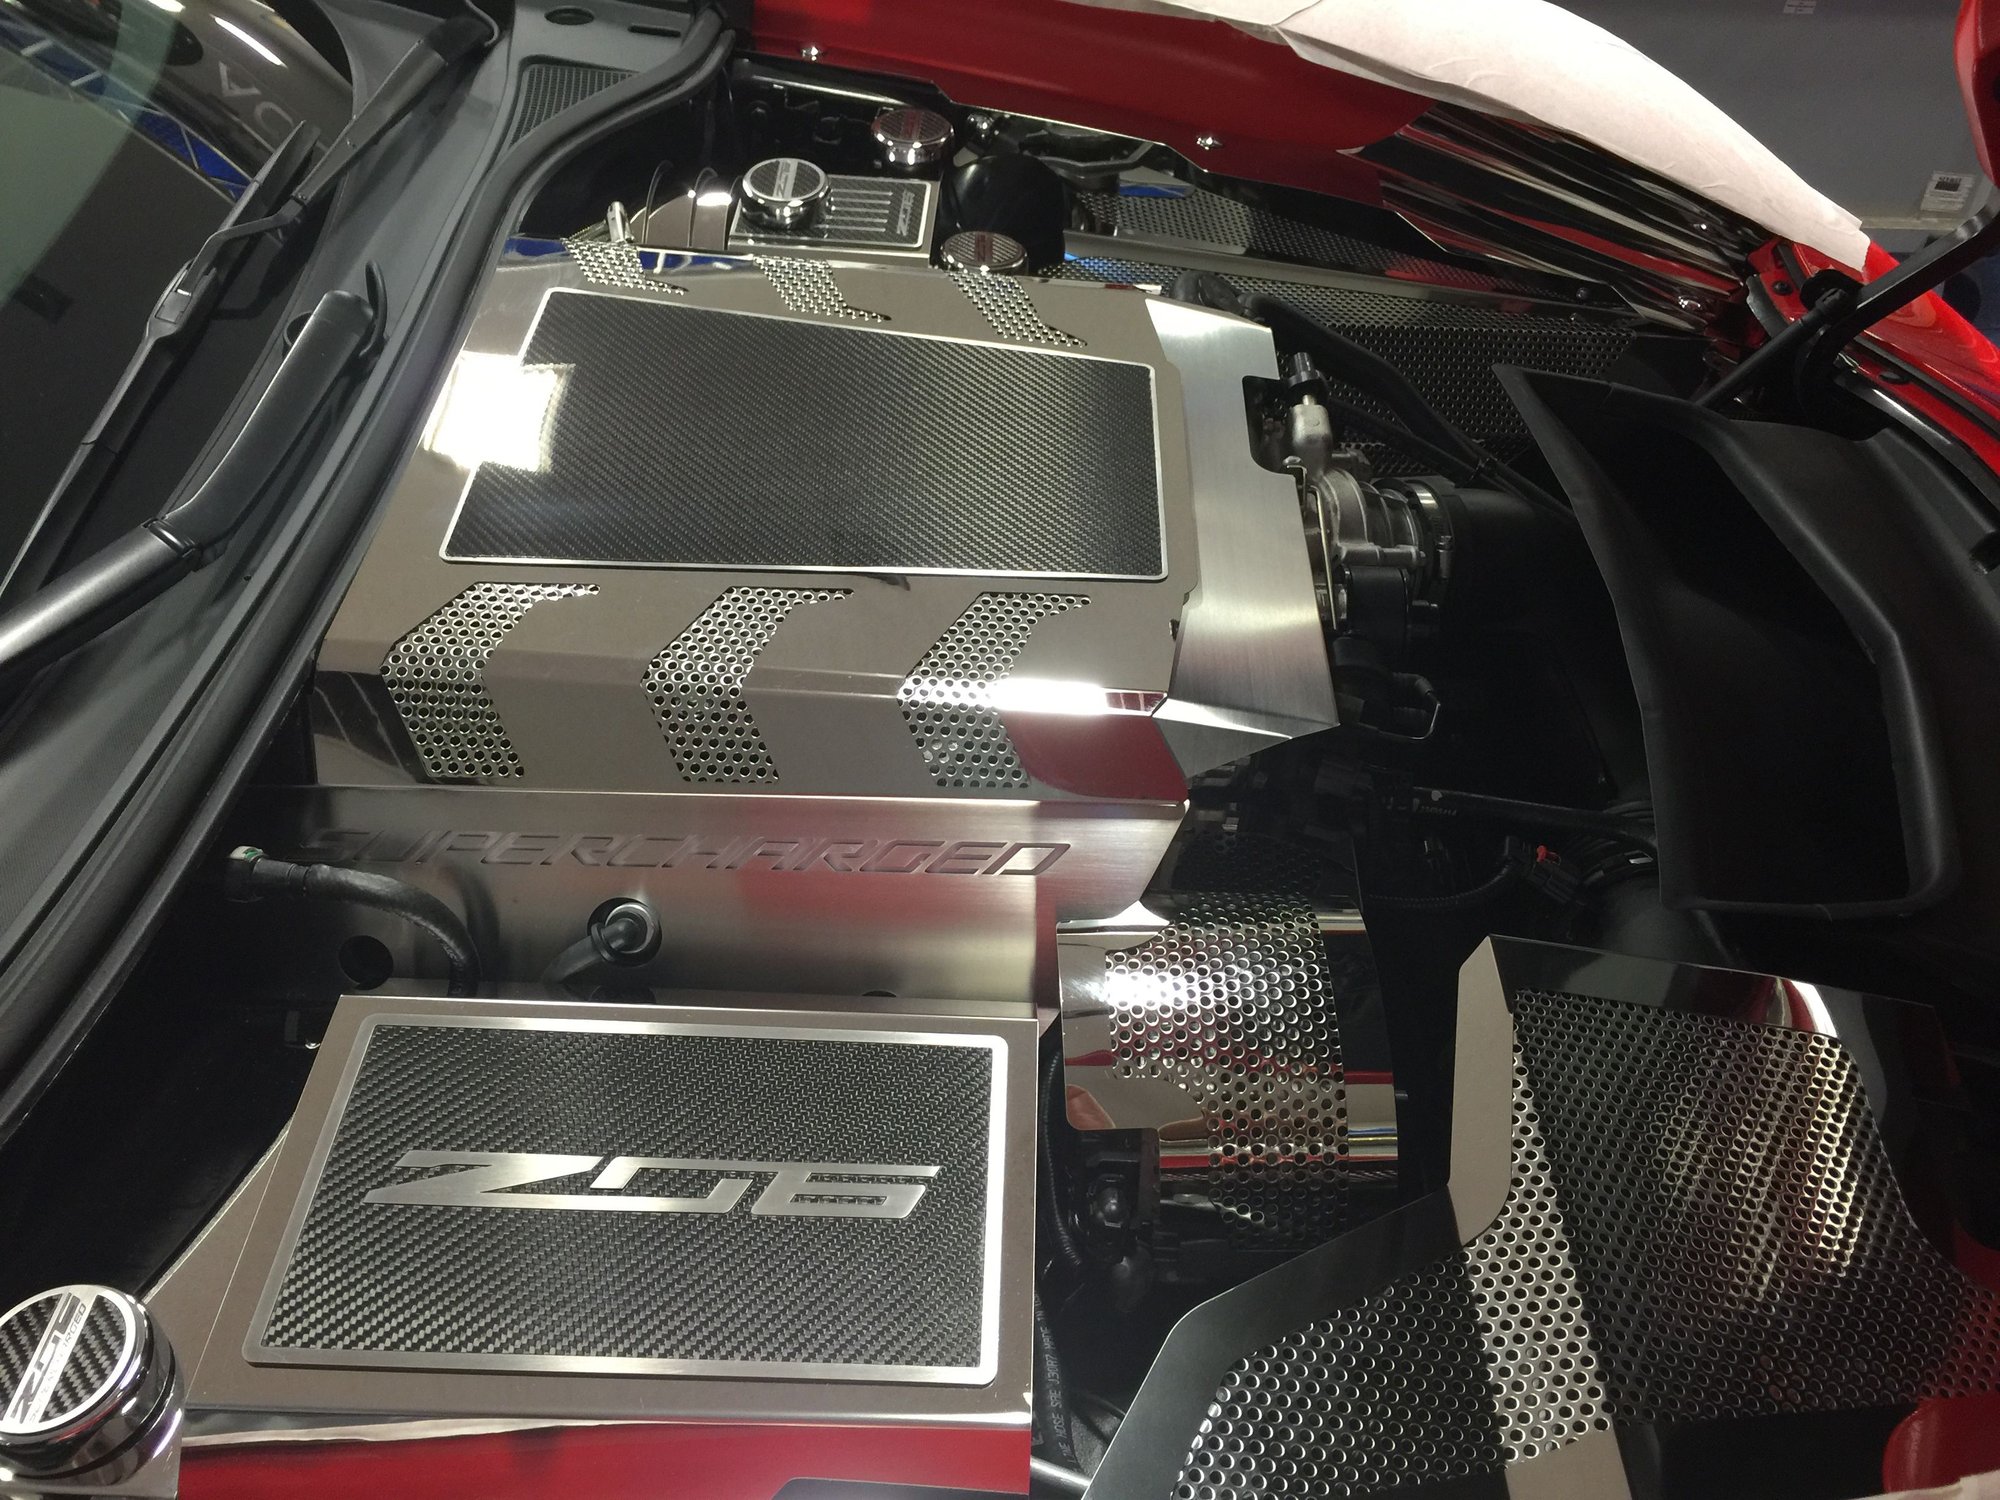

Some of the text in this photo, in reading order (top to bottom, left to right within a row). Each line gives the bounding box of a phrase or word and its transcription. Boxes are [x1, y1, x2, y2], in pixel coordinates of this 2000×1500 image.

[288, 829, 1071, 877] SUPERCHARGED
[362, 1150, 941, 1218] Z06
[1040, 1326, 1056, 1350] MADE
[1049, 1389, 1062, 1408] SAE
[1051, 1412, 1067, 1438] HOSE
